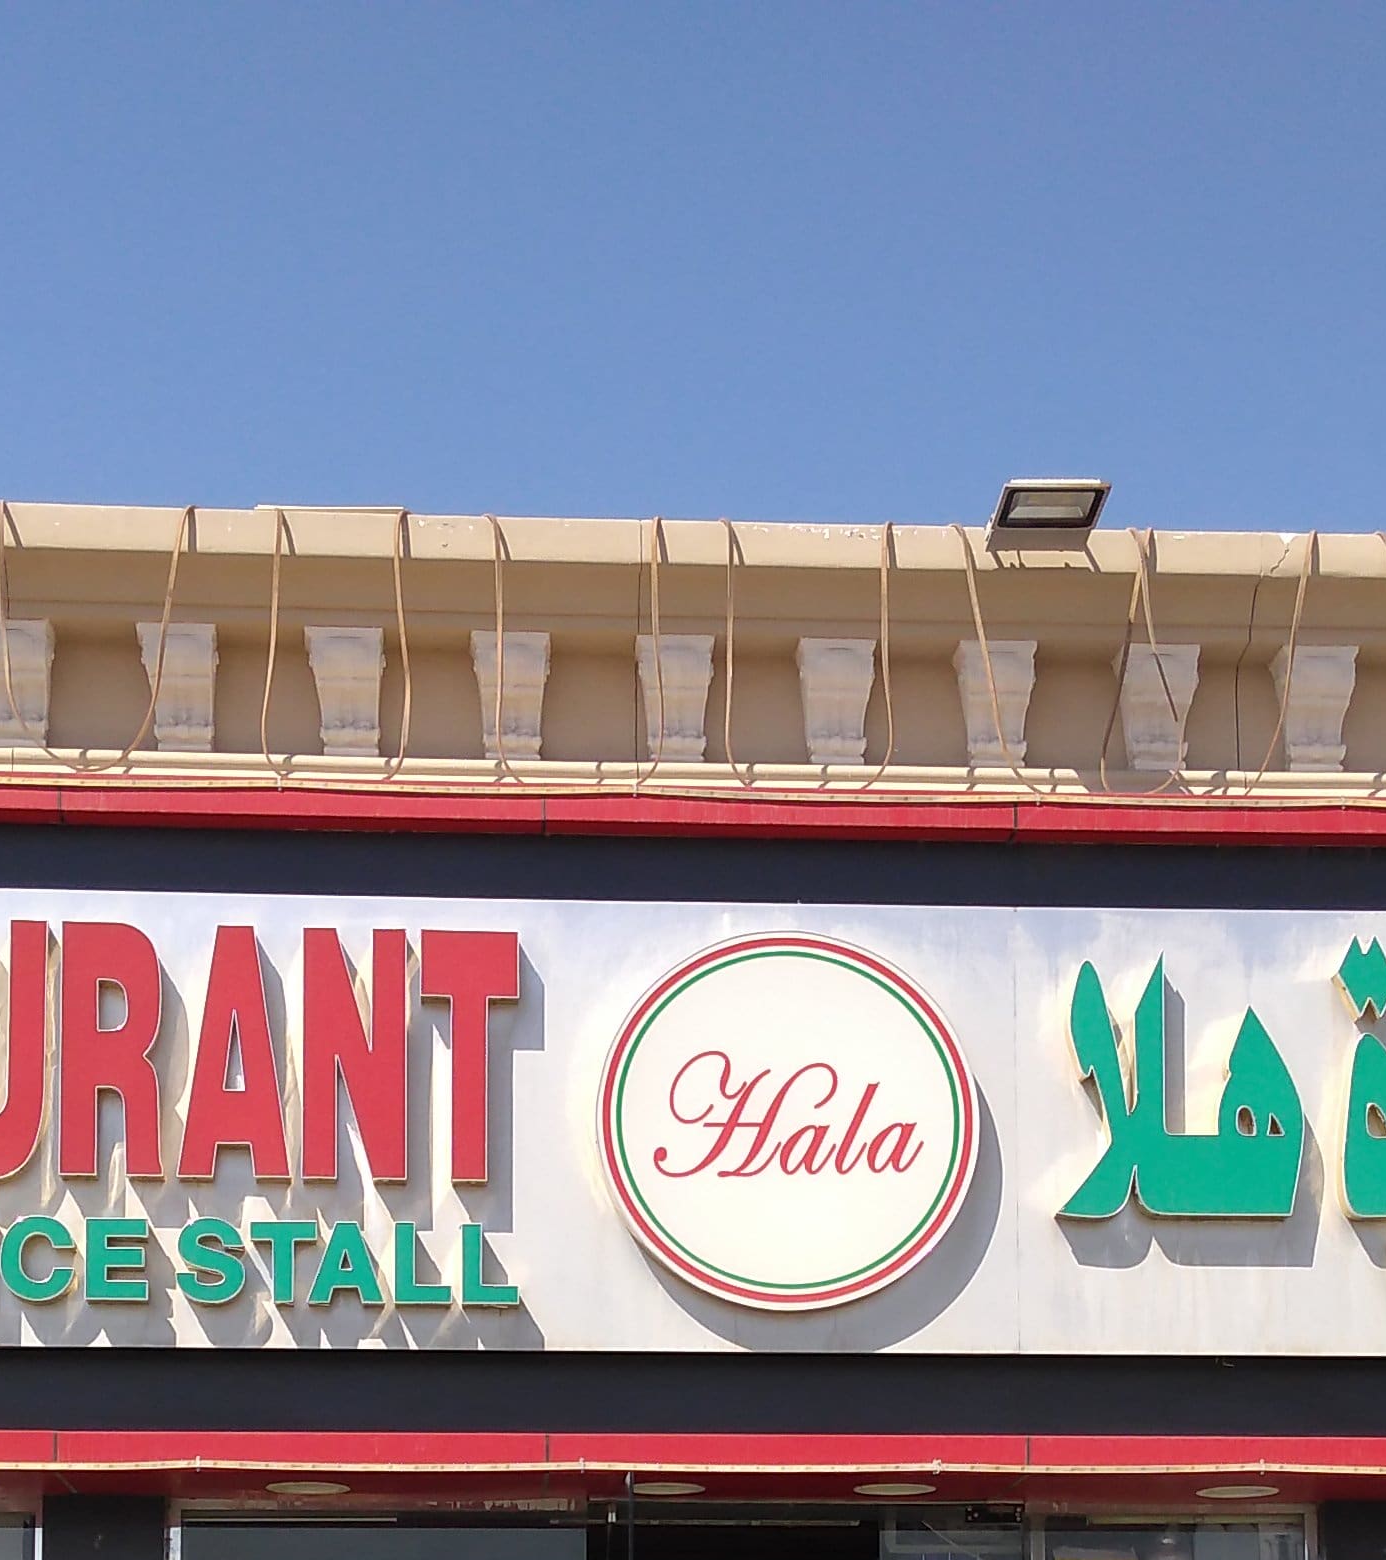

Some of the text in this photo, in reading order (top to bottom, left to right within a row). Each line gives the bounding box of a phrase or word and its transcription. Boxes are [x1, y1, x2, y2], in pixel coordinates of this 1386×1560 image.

[654, 1050, 924, 1178] Hala
[1056, 952, 1304, 1219] هلا
[176, 1217, 520, 1306] STALL
